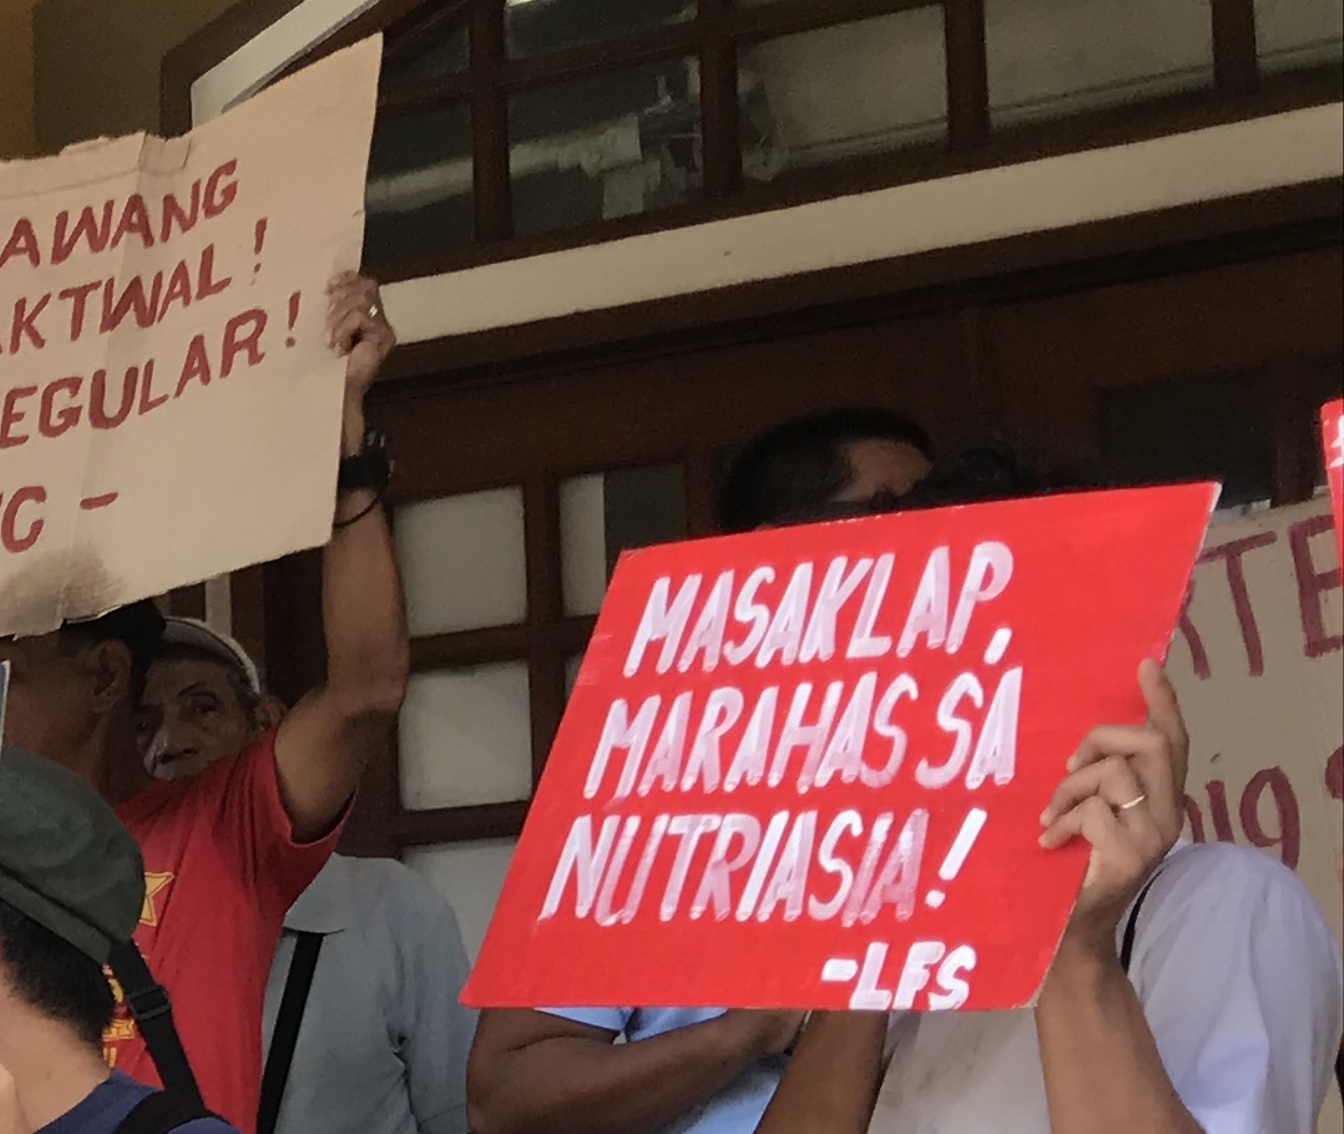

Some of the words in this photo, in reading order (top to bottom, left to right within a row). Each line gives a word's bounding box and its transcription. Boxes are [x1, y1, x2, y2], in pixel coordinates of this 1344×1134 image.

[623, 540, 1014, 677] MASAKLAP,
[584, 671, 918, 798] MARAHAS
[915, 666, 1023, 789] SA
[538, 808, 987, 928] NUTRIASIA!
